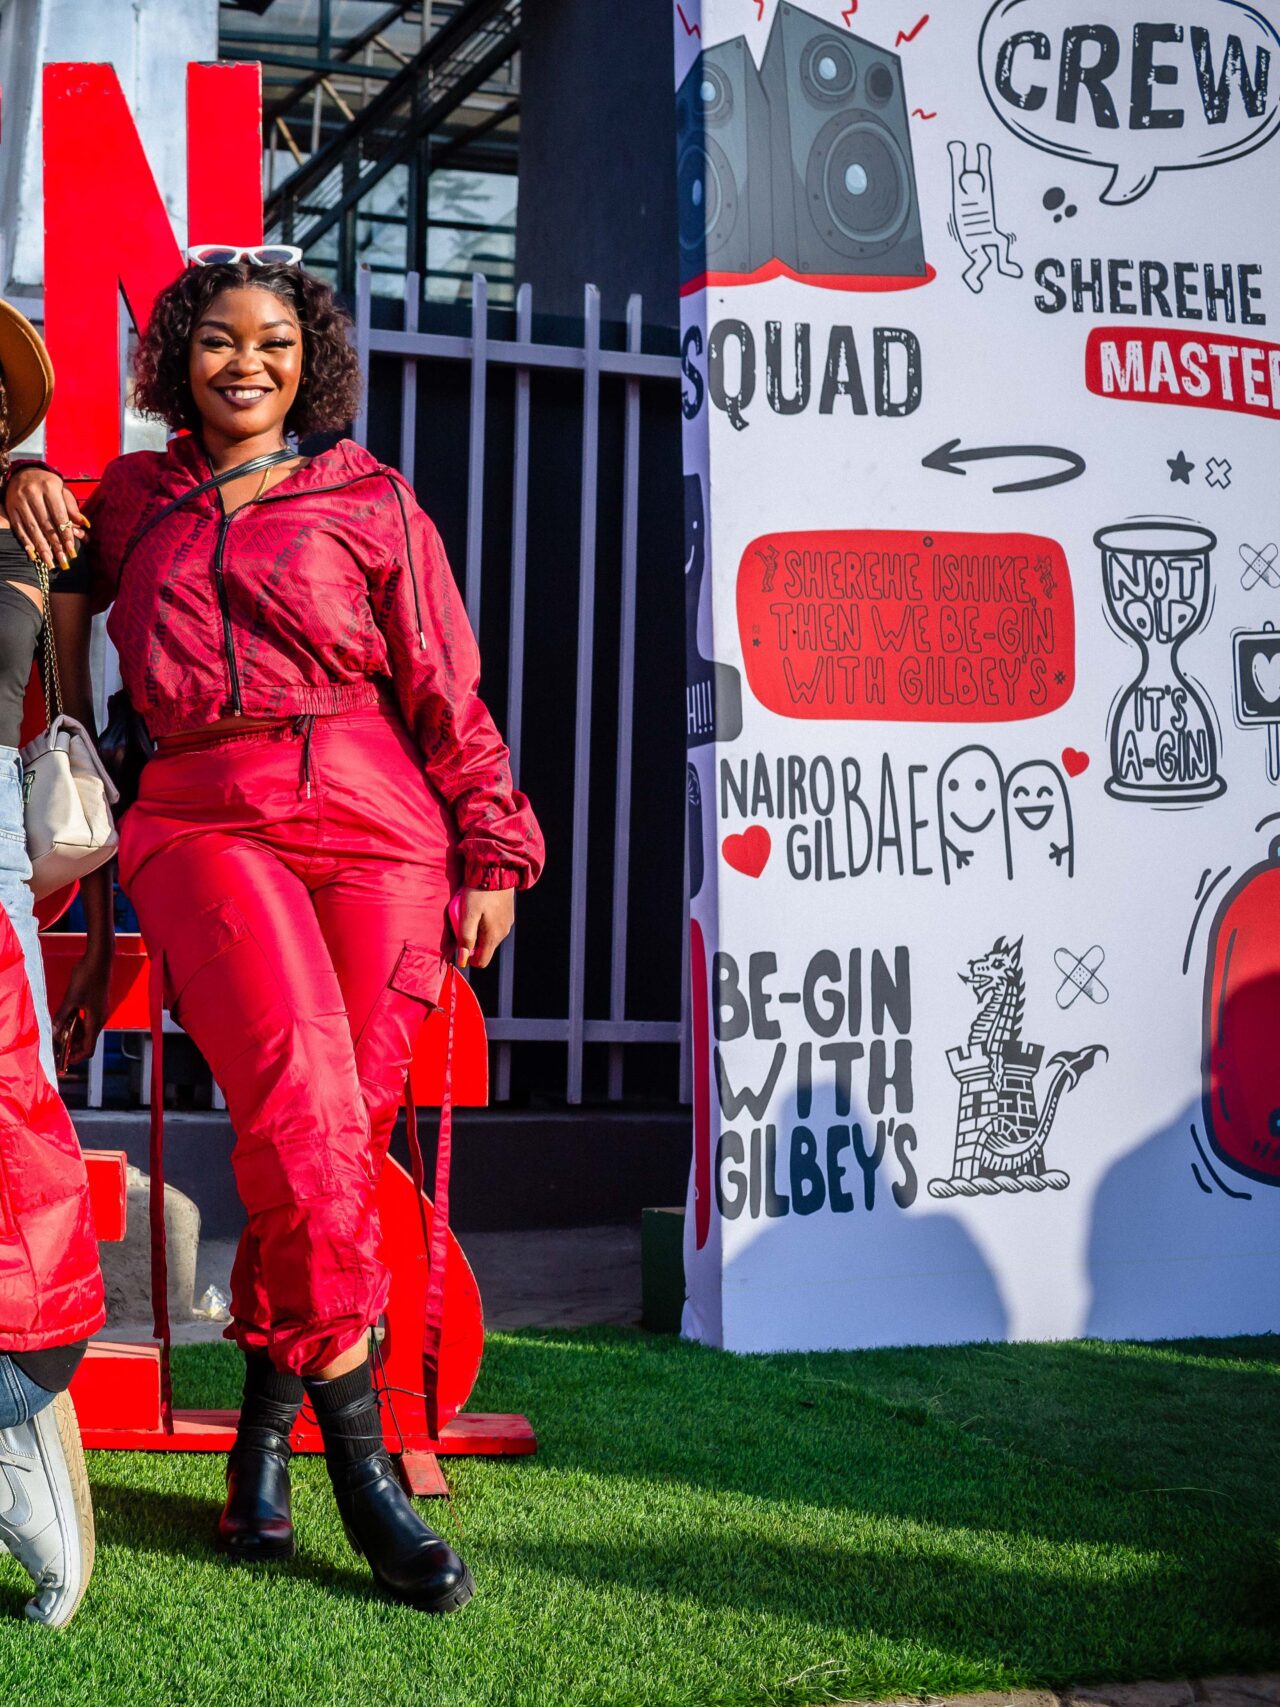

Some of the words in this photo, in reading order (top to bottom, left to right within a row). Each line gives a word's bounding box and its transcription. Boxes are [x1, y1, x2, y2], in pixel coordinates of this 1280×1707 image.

[995, 22, 1270, 130] CREW
[1034, 257, 1266, 326] SHEREHE
[681, 318, 922, 431] SQUAD
[784, 551, 923, 600] SHEREHE
[1108, 552, 1204, 601] NOT
[770, 602, 862, 651] THEN
[871, 604, 931, 652] WE
[939, 604, 1055, 654] BE-GIN
[1123, 599, 1198, 644] OLD
[783, 655, 886, 704] WITH
[898, 652, 1048, 706] GILBEY'S
[1134, 685, 1189, 732] IT'S
[1120, 729, 1209, 782] A-GIN
[712, 945, 912, 1042] BE-GIN
[714, 1038, 914, 1122] WITH
[715, 1117, 918, 1221] GILBEY'S
